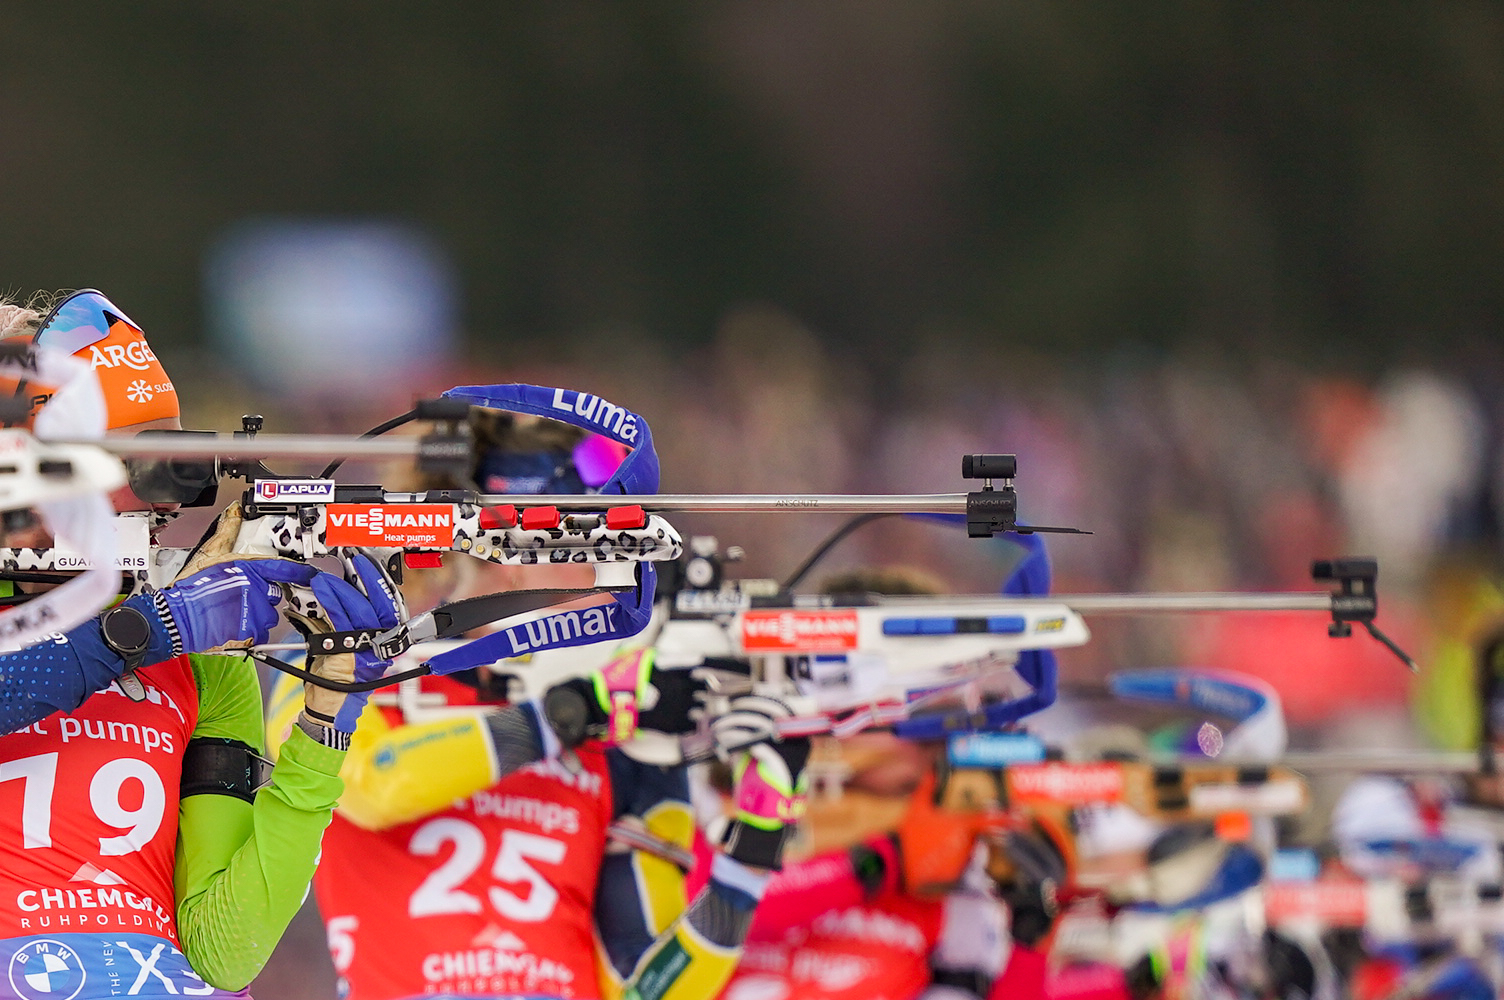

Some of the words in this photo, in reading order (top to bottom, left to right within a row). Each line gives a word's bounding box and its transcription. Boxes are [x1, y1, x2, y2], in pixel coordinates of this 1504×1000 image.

[280, 485, 328, 494] LAPUA
[330, 508, 450, 535] VIESSMANN
[384, 533, 405, 542] Heat
[407, 535, 436, 546] pumps
[58, 557, 145, 567] GUAARIS
[506, 604, 616, 653] Lumar
[59, 717, 174, 755] pumps
[472, 790, 580, 835] pumps
[408, 817, 567, 923] 25
[21, 914, 176, 939] RUHPOLDING
